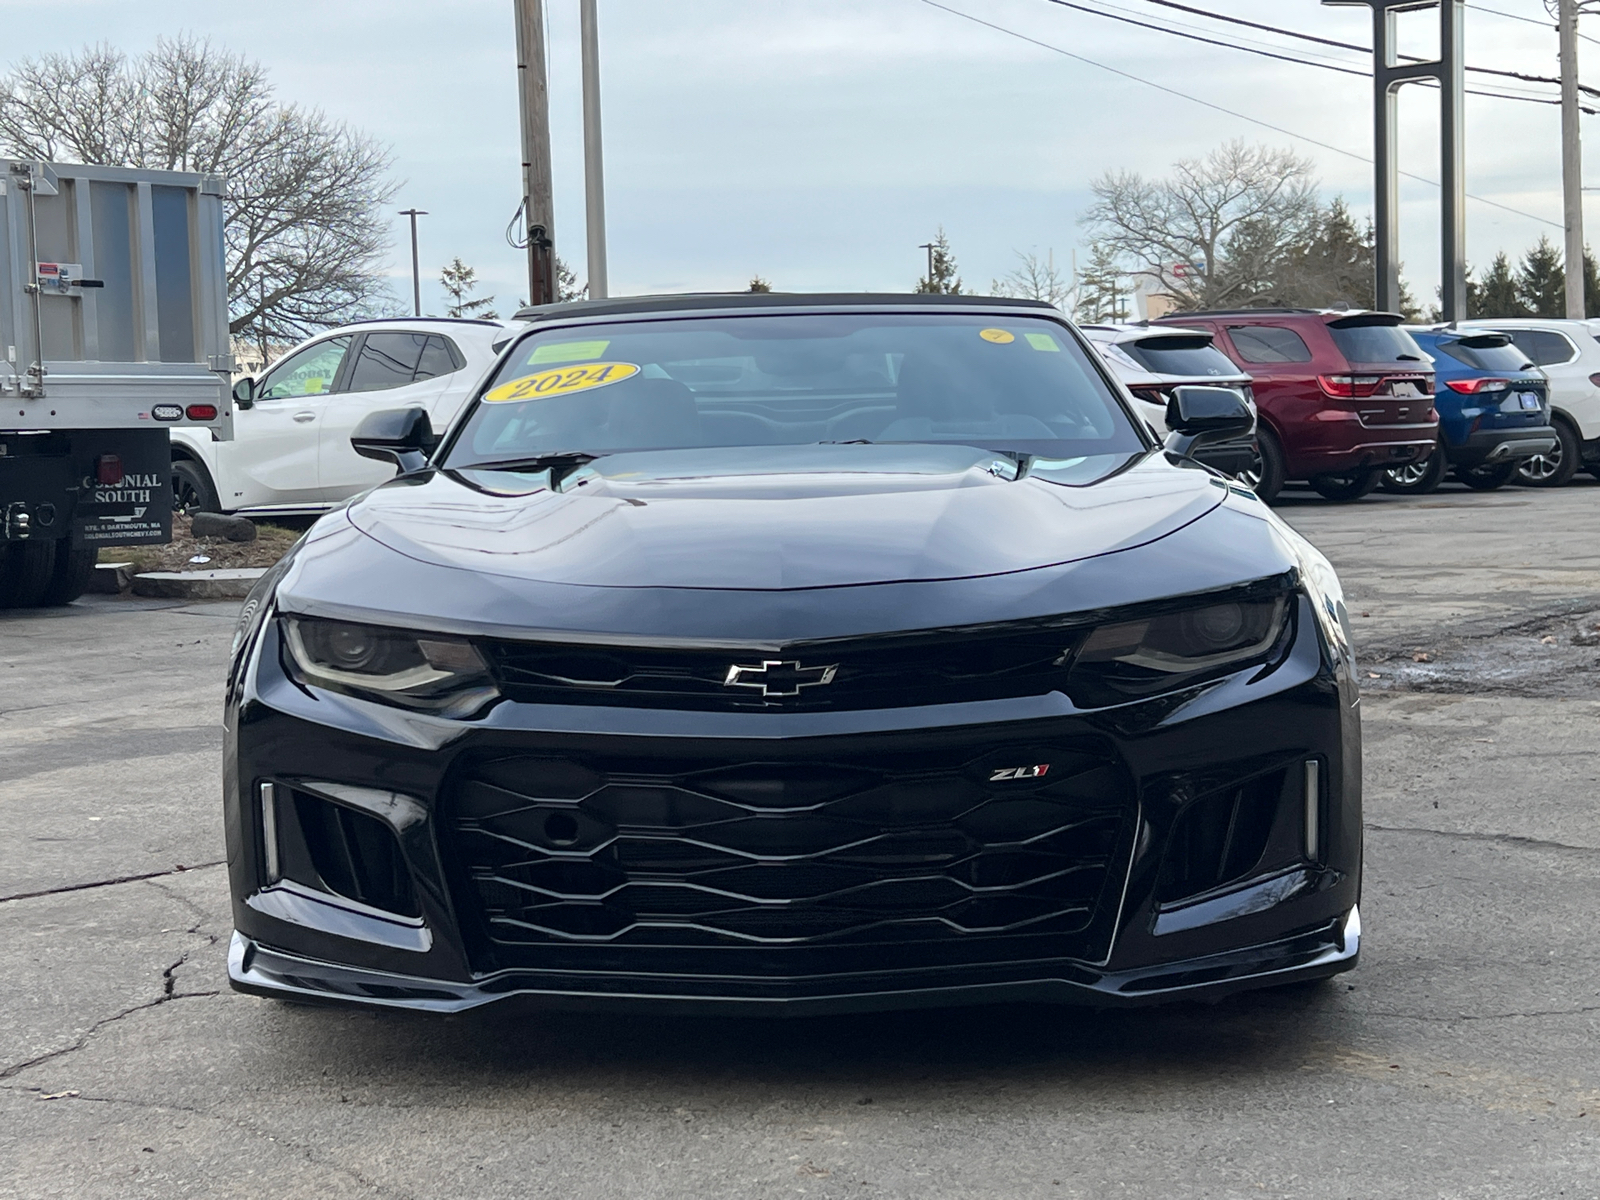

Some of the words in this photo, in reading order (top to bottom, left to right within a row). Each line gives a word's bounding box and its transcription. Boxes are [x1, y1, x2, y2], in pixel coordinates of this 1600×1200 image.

[506, 365, 615, 399] 2024
[95, 490, 150, 502] SOUTH
[989, 764, 1050, 781] ZL1
